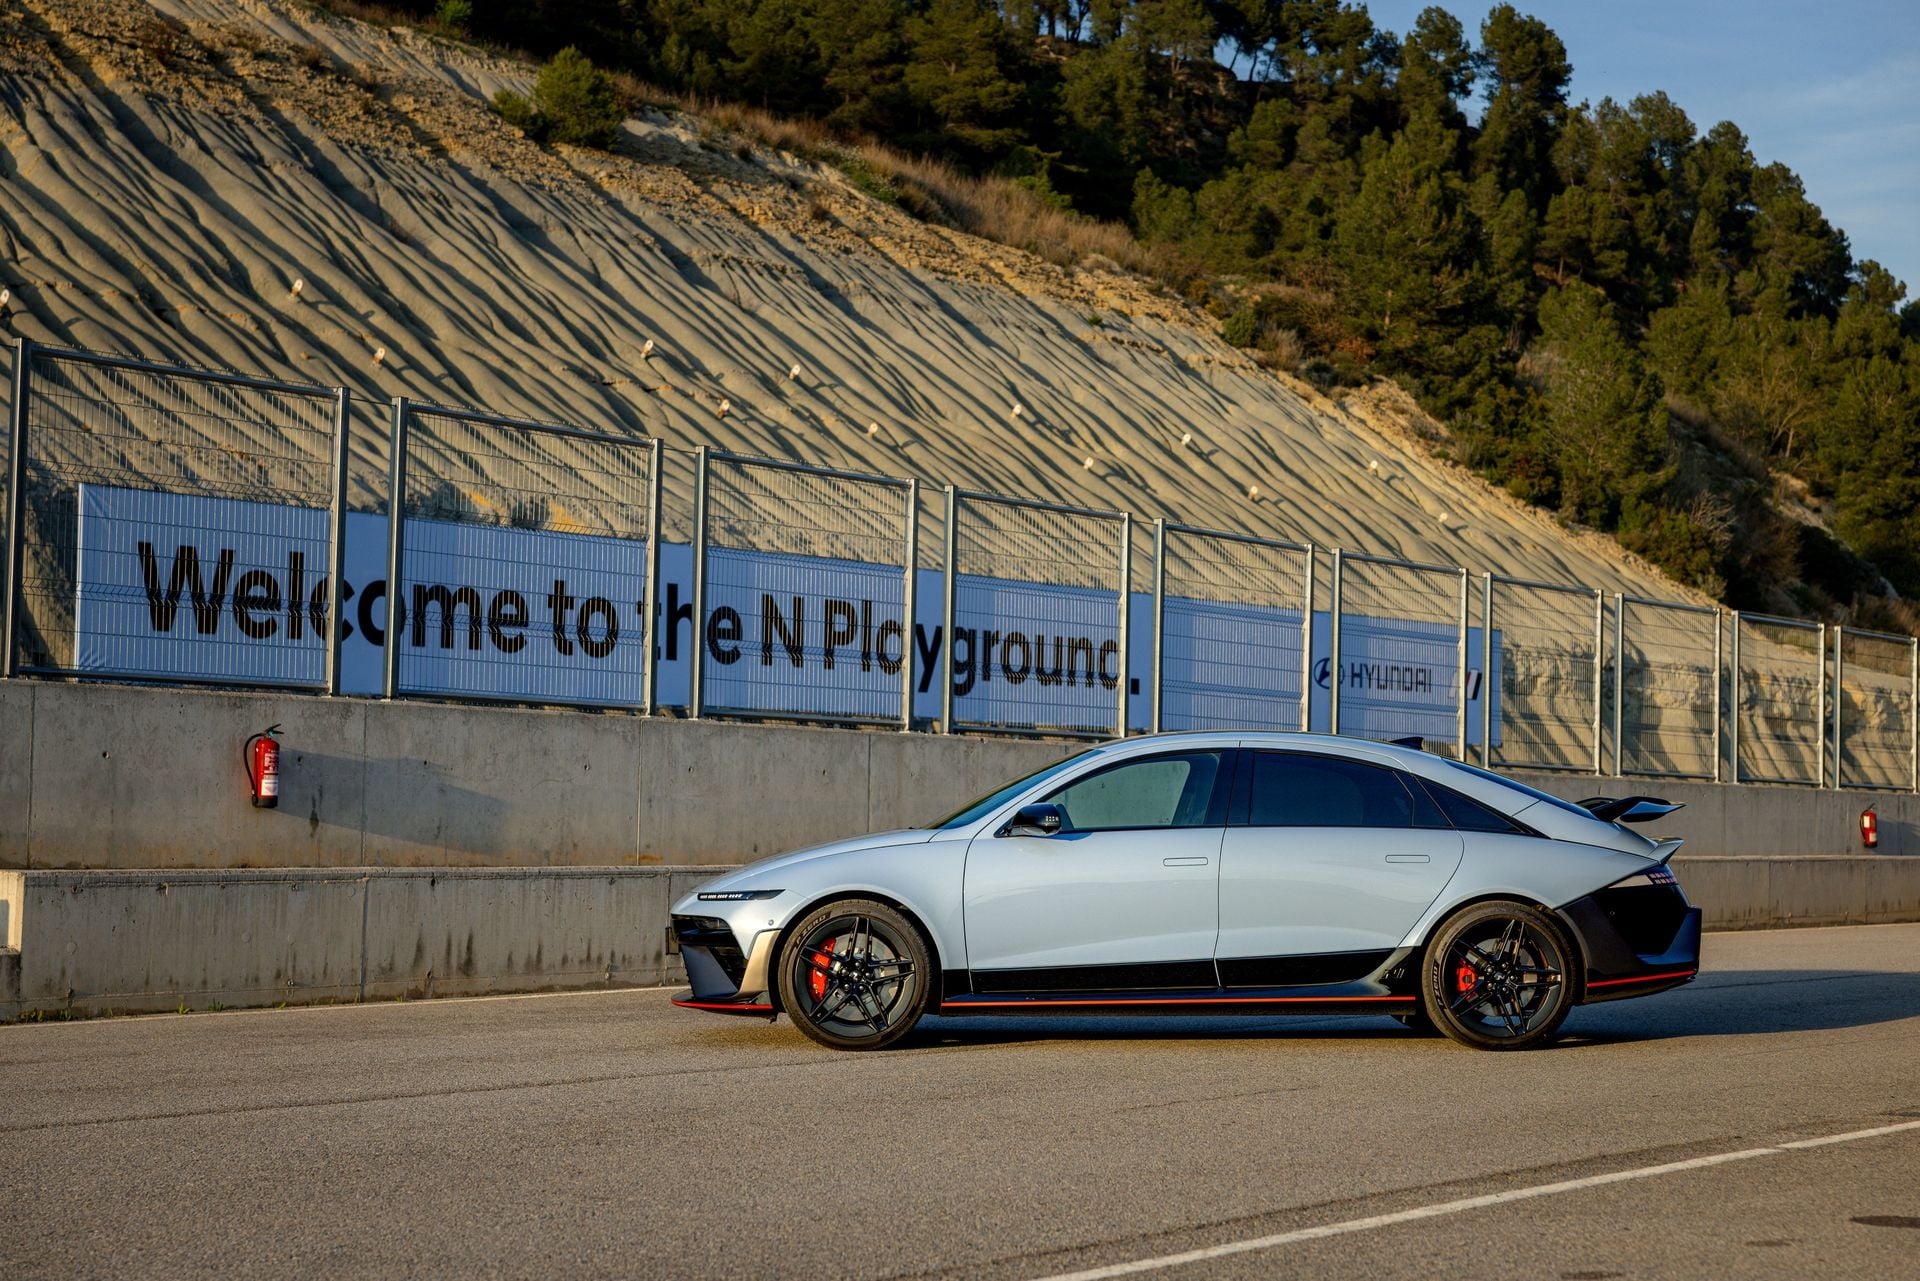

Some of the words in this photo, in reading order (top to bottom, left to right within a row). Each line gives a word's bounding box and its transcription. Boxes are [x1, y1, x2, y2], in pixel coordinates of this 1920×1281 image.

[138, 541, 529, 654] Welcome
[548, 579, 619, 658] to
[637, 583, 743, 665] he
[761, 593, 804, 669] N
[1351, 662, 1432, 693] HYUNDAI
